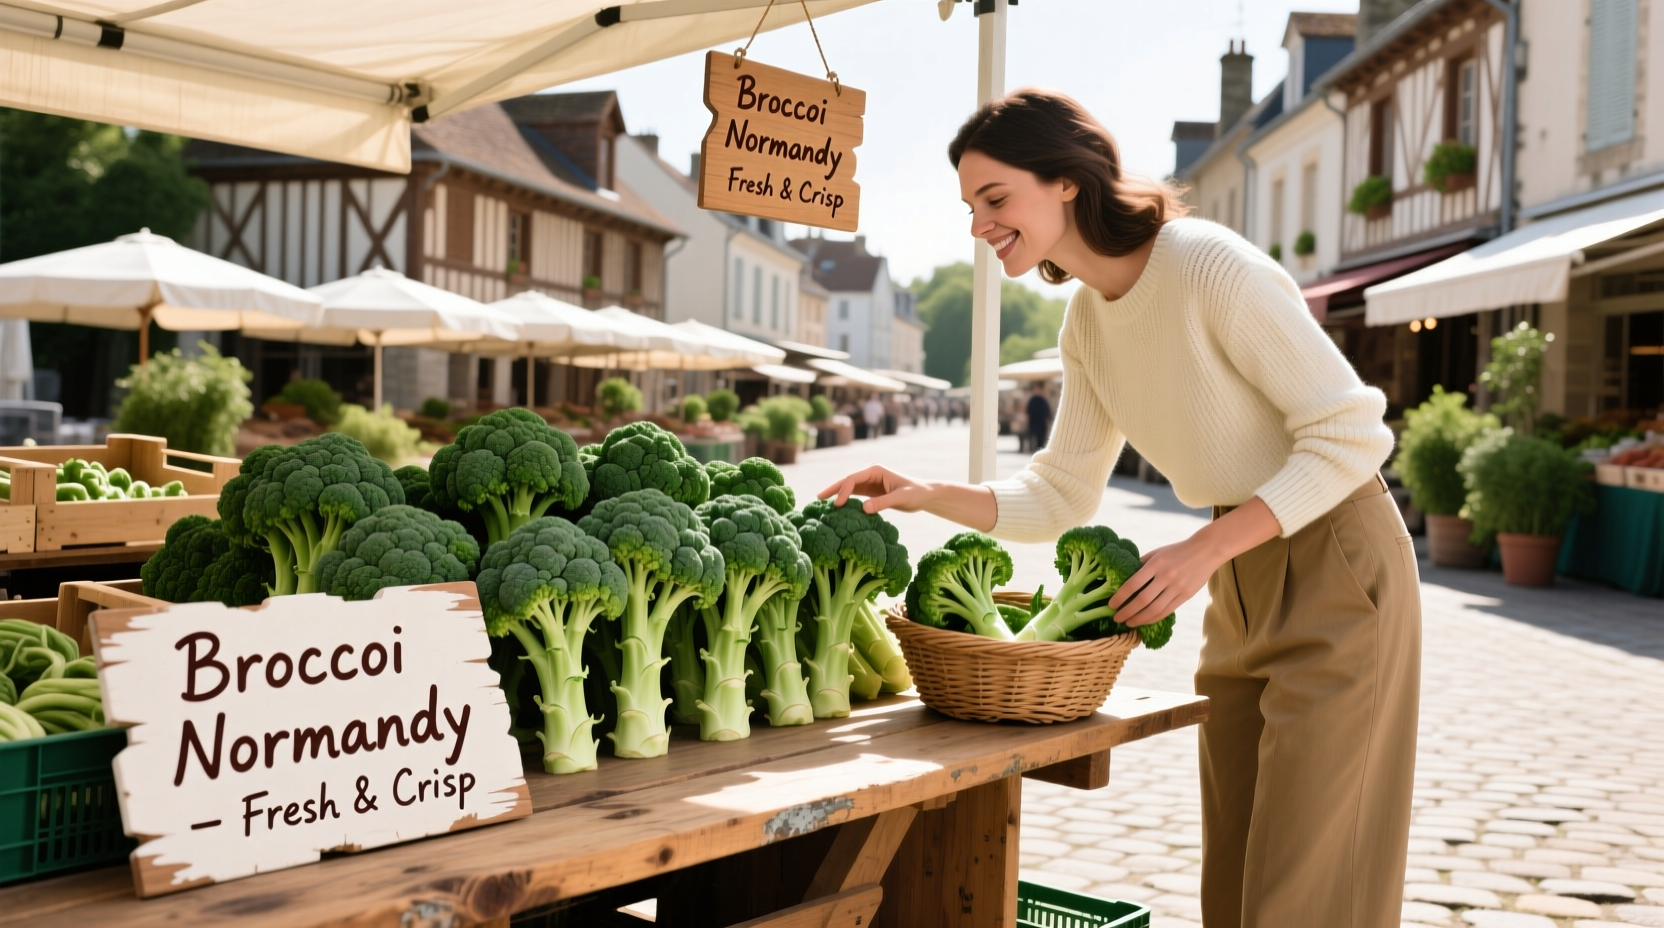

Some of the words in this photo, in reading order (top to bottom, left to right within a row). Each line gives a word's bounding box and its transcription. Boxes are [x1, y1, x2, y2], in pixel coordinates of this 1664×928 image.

[737, 74, 828, 125] Broccoi
[725, 119, 843, 180] Normandy
[728, 167, 773, 197] Fresh
[780, 177, 793, 201] &
[799, 181, 844, 218] Crisp
[174, 625, 403, 702] Broccoi
[173, 684, 471, 787] Normandy
[242, 781, 341, 837] Fresh
[353, 775, 379, 813] &
[392, 767, 476, 810] Crisp
